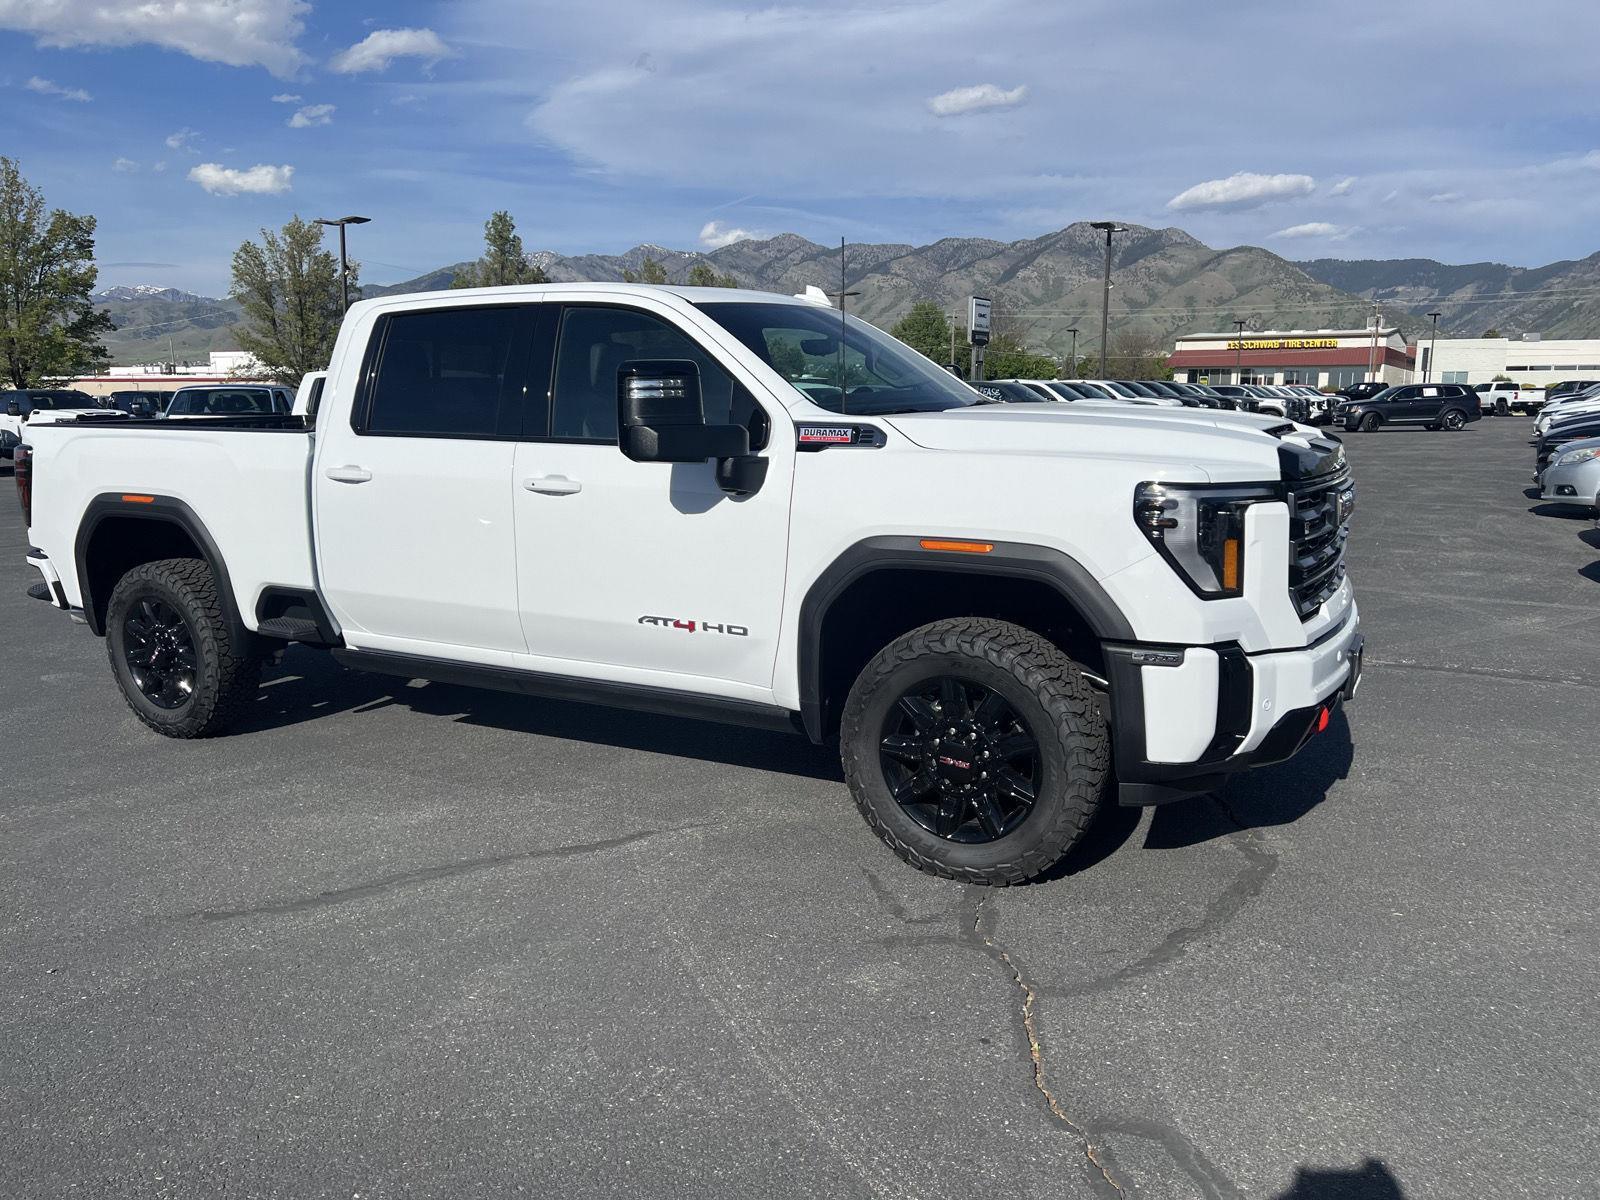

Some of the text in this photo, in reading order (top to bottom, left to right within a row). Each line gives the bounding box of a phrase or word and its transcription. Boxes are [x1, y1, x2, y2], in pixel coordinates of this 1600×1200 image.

[1226, 339, 1338, 350] LES SCHWAB TIRE CENTER
[803, 428, 849, 437] DURAMAX
[638, 615, 749, 636] AT4 HD
